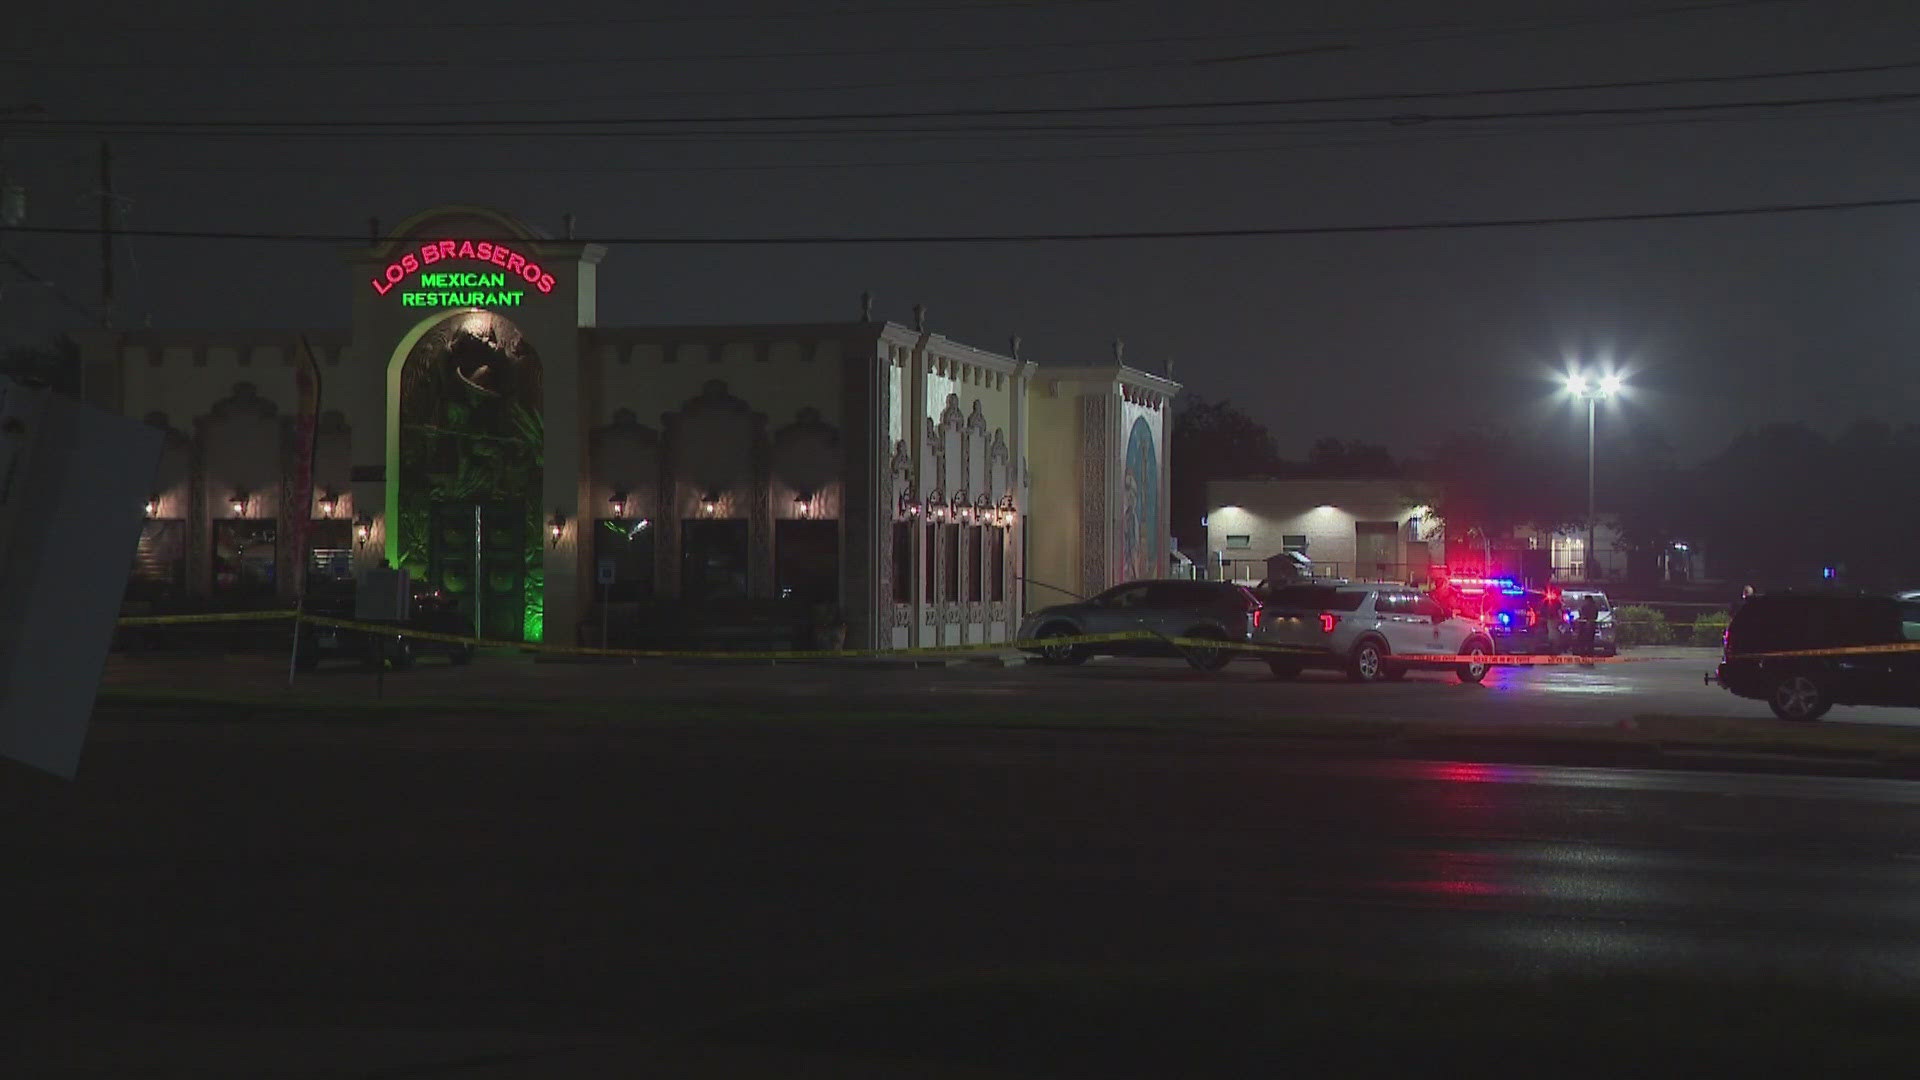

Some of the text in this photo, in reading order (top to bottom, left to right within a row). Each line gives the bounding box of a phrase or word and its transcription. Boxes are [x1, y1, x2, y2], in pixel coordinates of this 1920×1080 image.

[371, 239, 557, 296] LOS BRASEROS
[420, 272, 505, 289] MEXICAN
[401, 290, 525, 307] RESTAURANT
